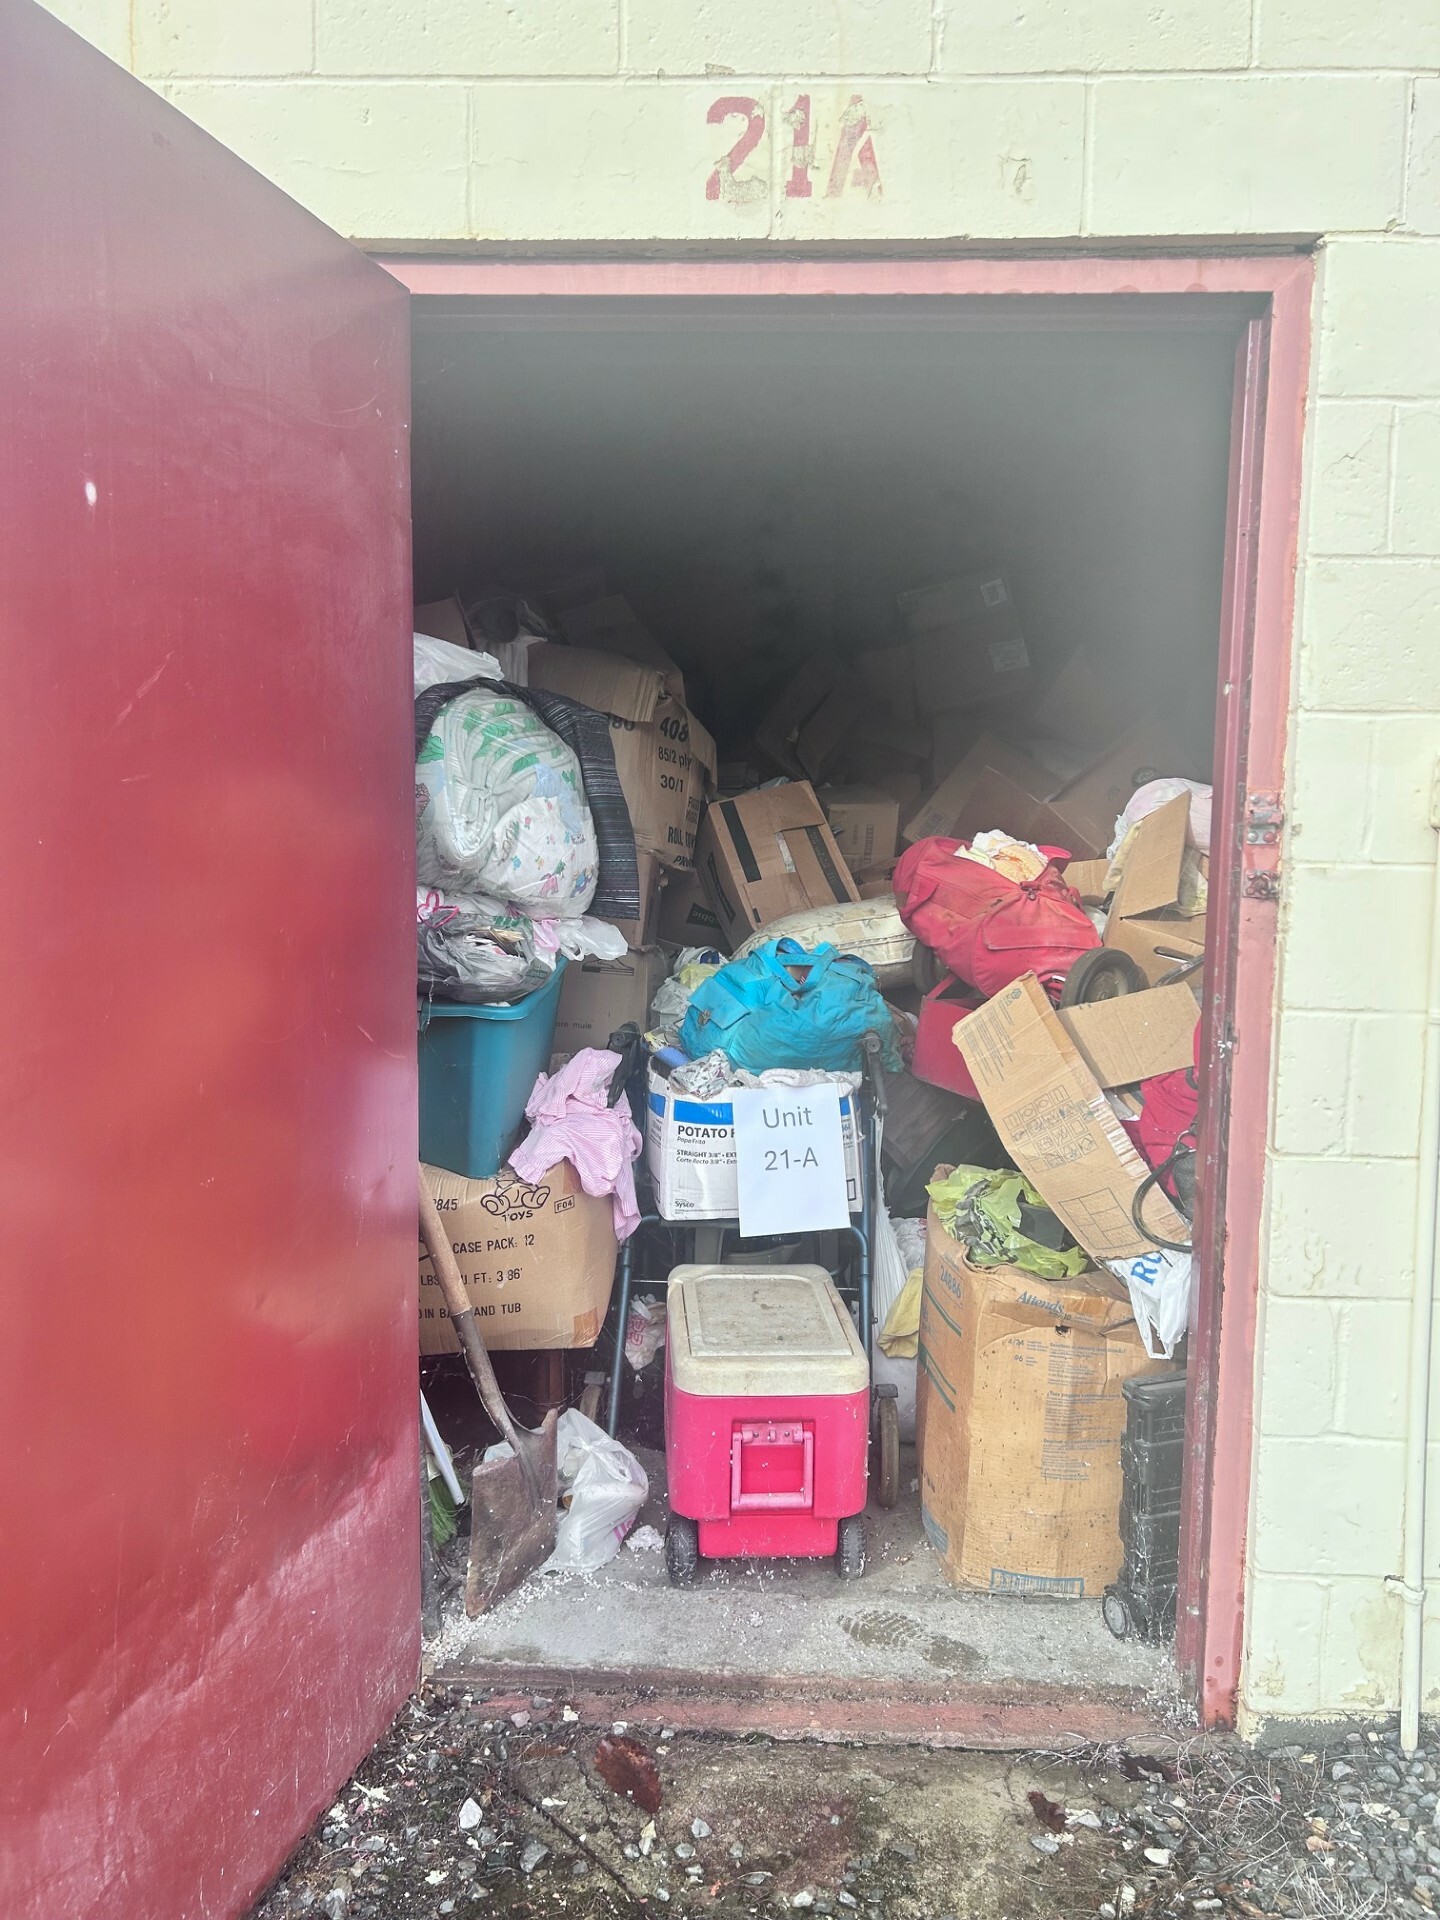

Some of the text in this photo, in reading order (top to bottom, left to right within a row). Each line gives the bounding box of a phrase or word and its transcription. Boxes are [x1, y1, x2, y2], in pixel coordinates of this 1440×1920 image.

[705, 94, 884, 201] 21A
[659, 716, 689, 743] 408
[658, 747, 692, 771] 85/2 ply
[660, 774, 684, 793] 30/1
[762, 1106, 813, 1129] Unit
[677, 1125, 728, 1139] POTATO
[676, 1149, 707, 1158] STRAIGHT
[764, 1146, 819, 1171] 21-A
[433, 1198, 458, 1211] 845
[556, 1199, 573, 1211] F04
[675, 1200, 695, 1209] Sysco
[501, 1209, 534, 1223] TOYS
[452, 1234, 535, 1254] CASE PACK: 12
[474, 1272, 492, 1285] FT:
[474, 1305, 496, 1317] AND
[501, 1302, 522, 1314] TUB
[1017, 1290, 1065, 1314] Attends
